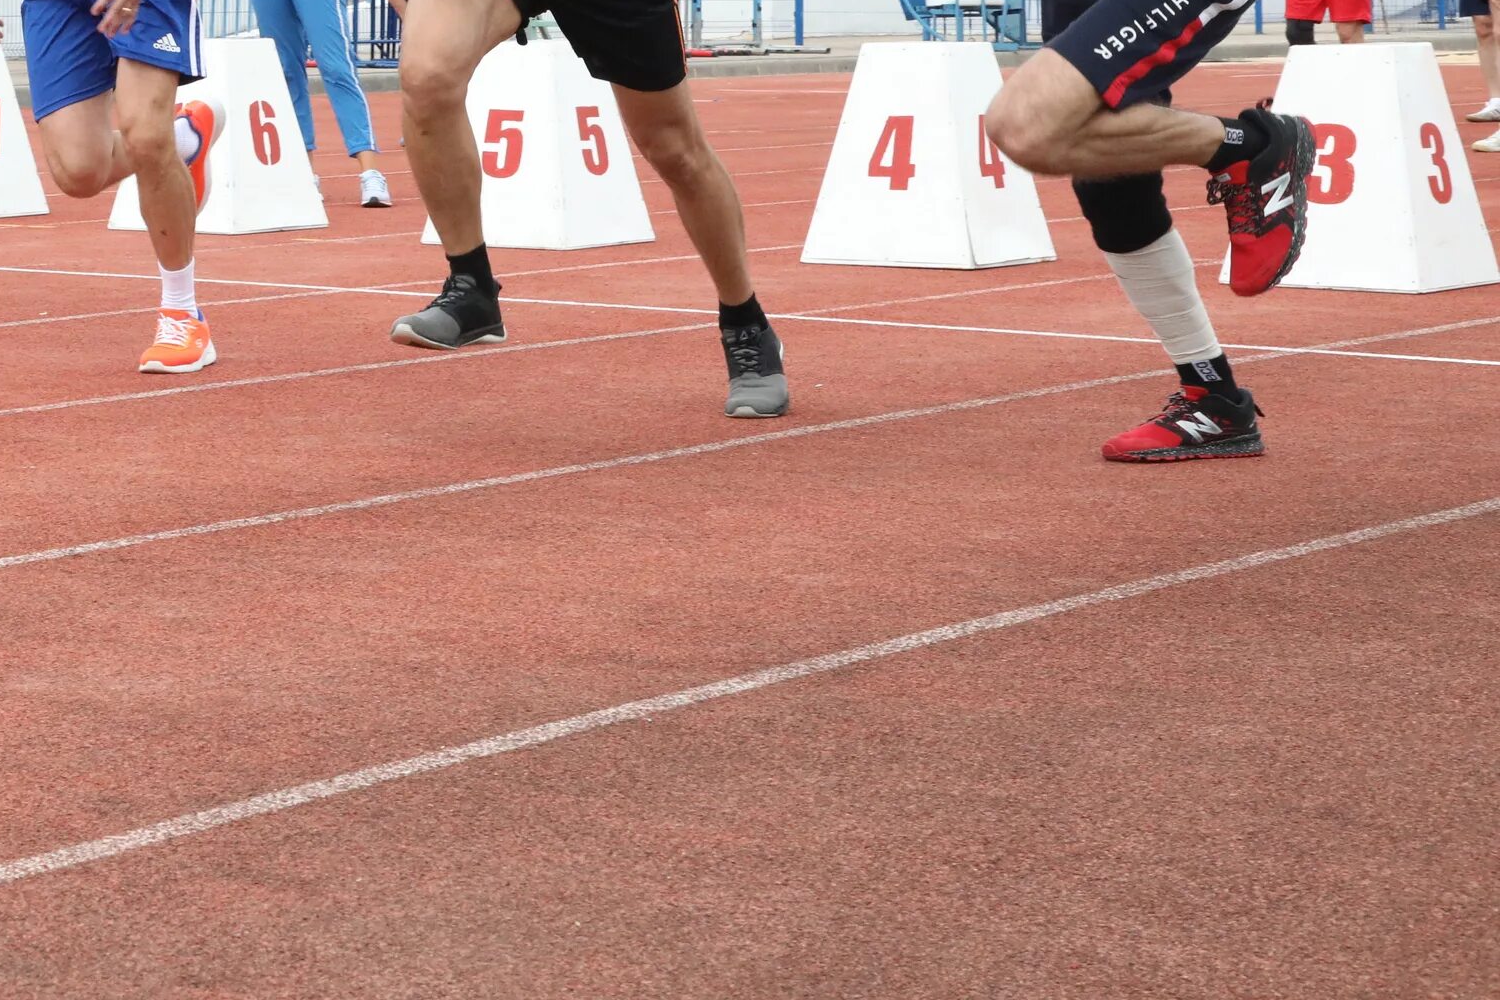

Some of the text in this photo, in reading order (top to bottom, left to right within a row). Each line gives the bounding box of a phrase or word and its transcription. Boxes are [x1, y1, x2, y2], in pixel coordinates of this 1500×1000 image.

[153, 42, 181, 53] adidas
[249, 100, 281, 166] 6
[482, 109, 524, 178] 5
[575, 106, 609, 175] 5
[867, 115, 916, 190] 4
[1303, 123, 1357, 204] 3
[1420, 122, 1452, 204] 3
